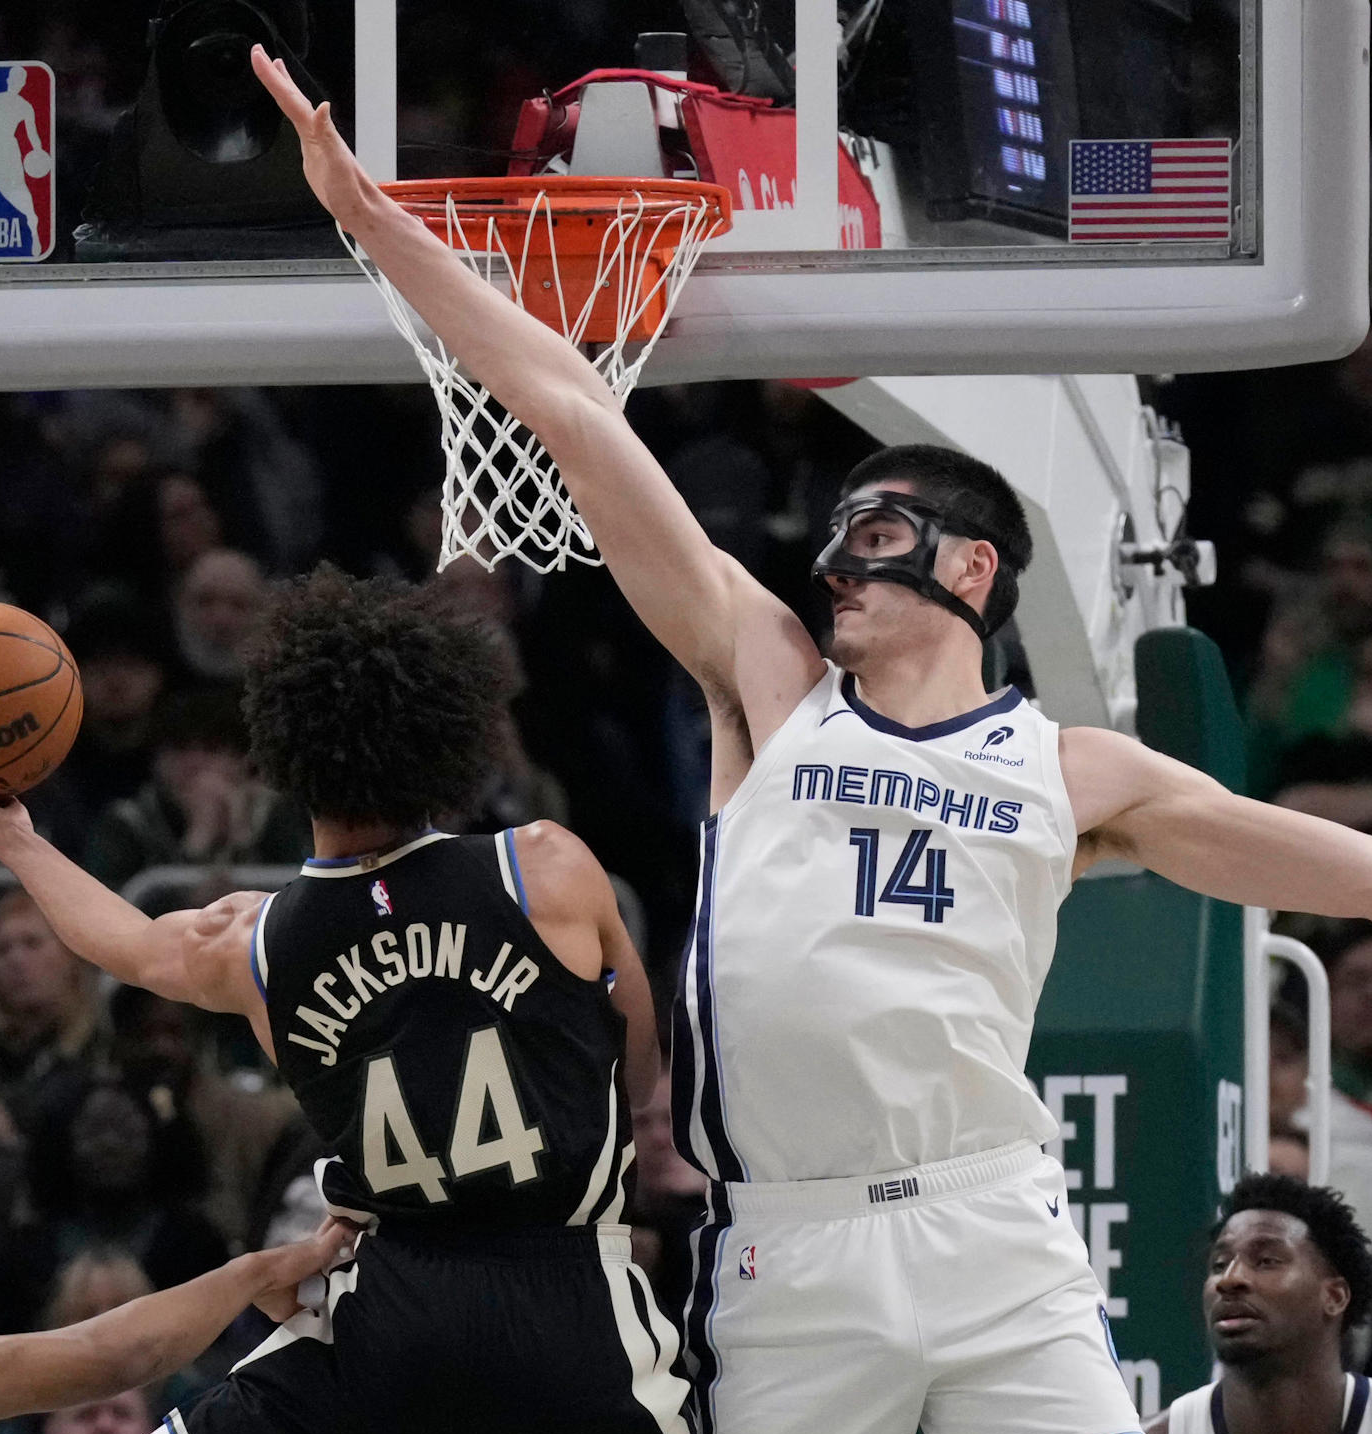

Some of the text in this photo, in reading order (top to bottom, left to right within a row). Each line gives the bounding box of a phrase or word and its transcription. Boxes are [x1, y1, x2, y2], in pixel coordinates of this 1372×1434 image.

[791, 763, 1024, 835] MEMPHIS
[963, 750, 1025, 768] Robinhood
[848, 826, 955, 924] 14
[287, 921, 541, 1067] JACKSON JR
[361, 1023, 550, 1205] 44
